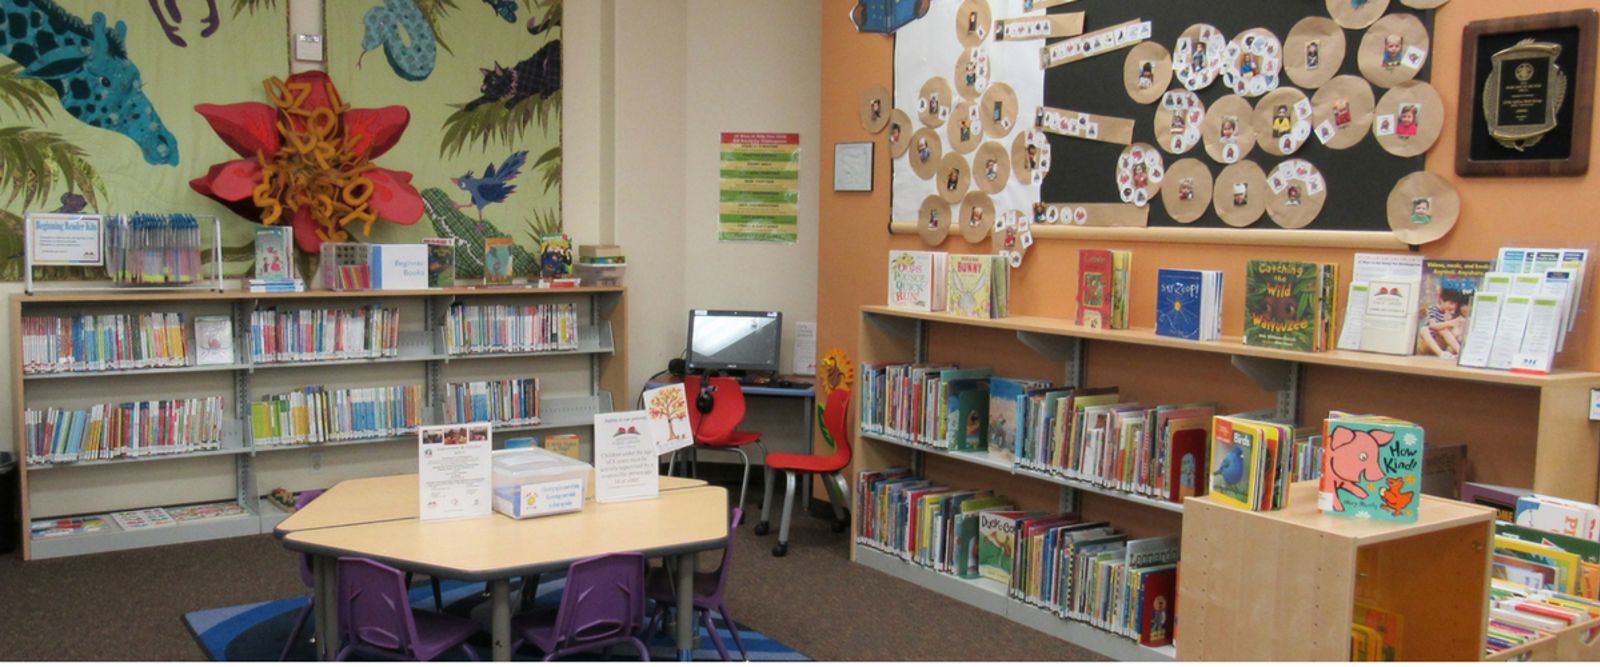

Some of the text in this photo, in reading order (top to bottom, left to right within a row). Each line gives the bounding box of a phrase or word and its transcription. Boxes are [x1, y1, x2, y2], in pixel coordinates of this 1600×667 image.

[36, 220, 64, 232] Beginning
[957, 261, 982, 273] BUNNY
[1259, 263, 1304, 278] Catching
[1266, 281, 1292, 298] Wild
[1233, 431, 1250, 447] Birds
[1389, 440, 1418, 457] How
[1383, 457, 1418, 473] Kind!
[981, 515, 1000, 529] Duck
